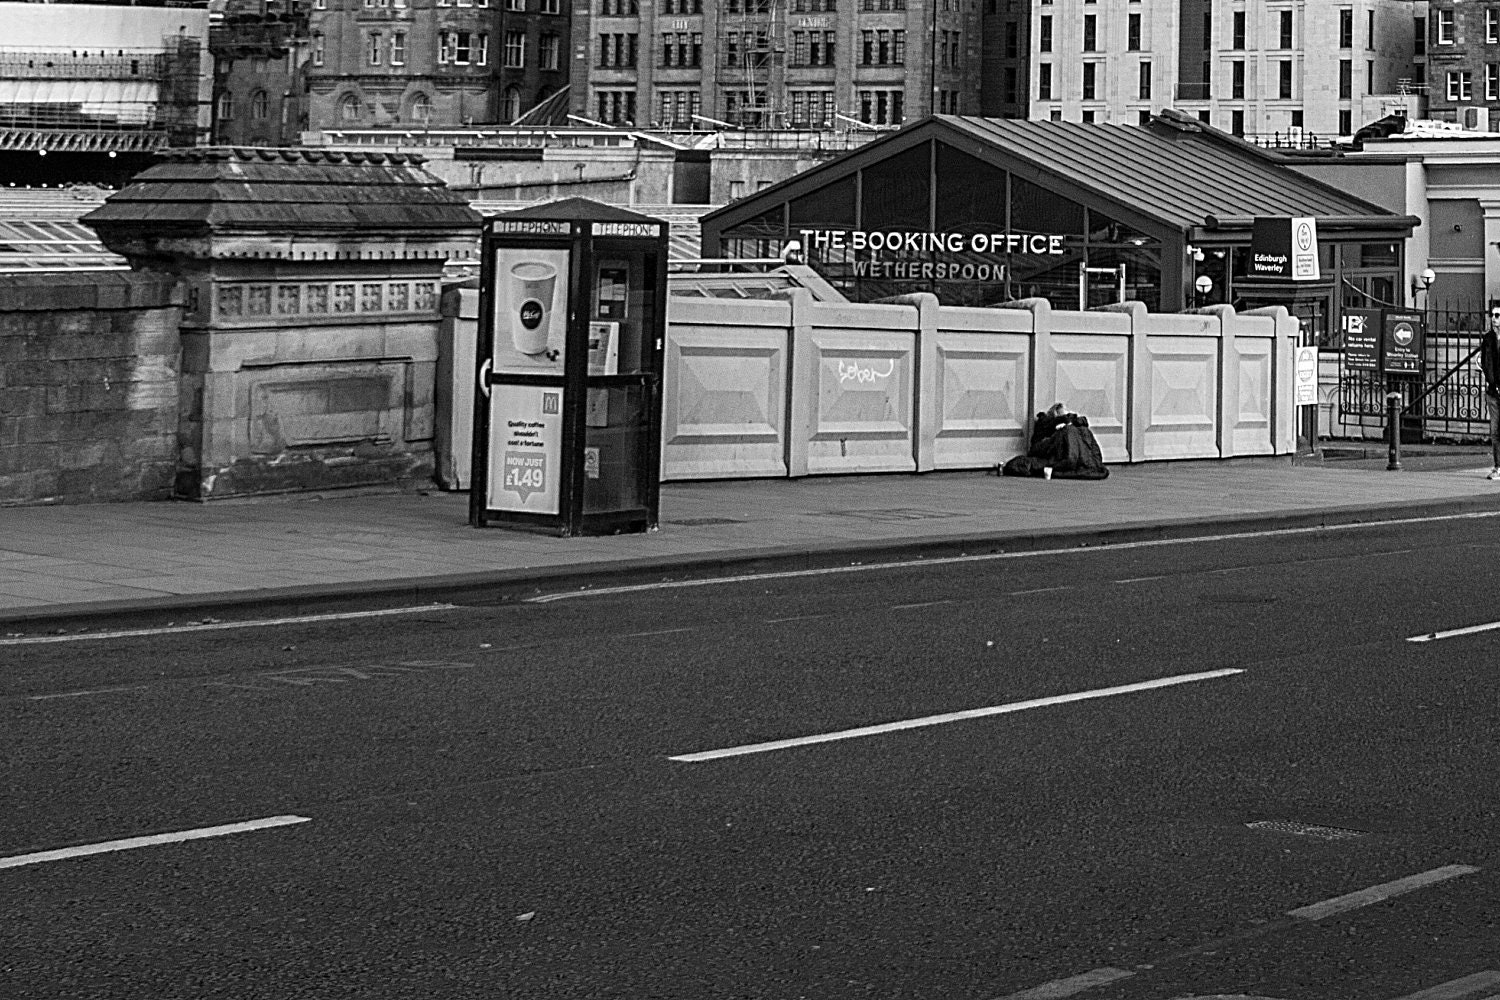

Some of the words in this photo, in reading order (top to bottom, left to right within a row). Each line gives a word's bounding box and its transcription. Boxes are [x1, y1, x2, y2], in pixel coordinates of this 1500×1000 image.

[501, 221, 564, 233] TELEPHONE
[601, 223, 655, 236] TELEPHONE
[800, 229, 845, 249] THE
[852, 231, 964, 251] BOOKING
[971, 233, 1064, 254] OFFICE
[1254, 253, 1287, 264] Edinburgh
[853, 261, 1006, 281] WETHERSPOON
[1254, 263, 1283, 273] Waverley
[506, 457, 525, 466] NOW
[525, 458, 544, 467] JUST
[506, 468, 544, 488] £1.49
